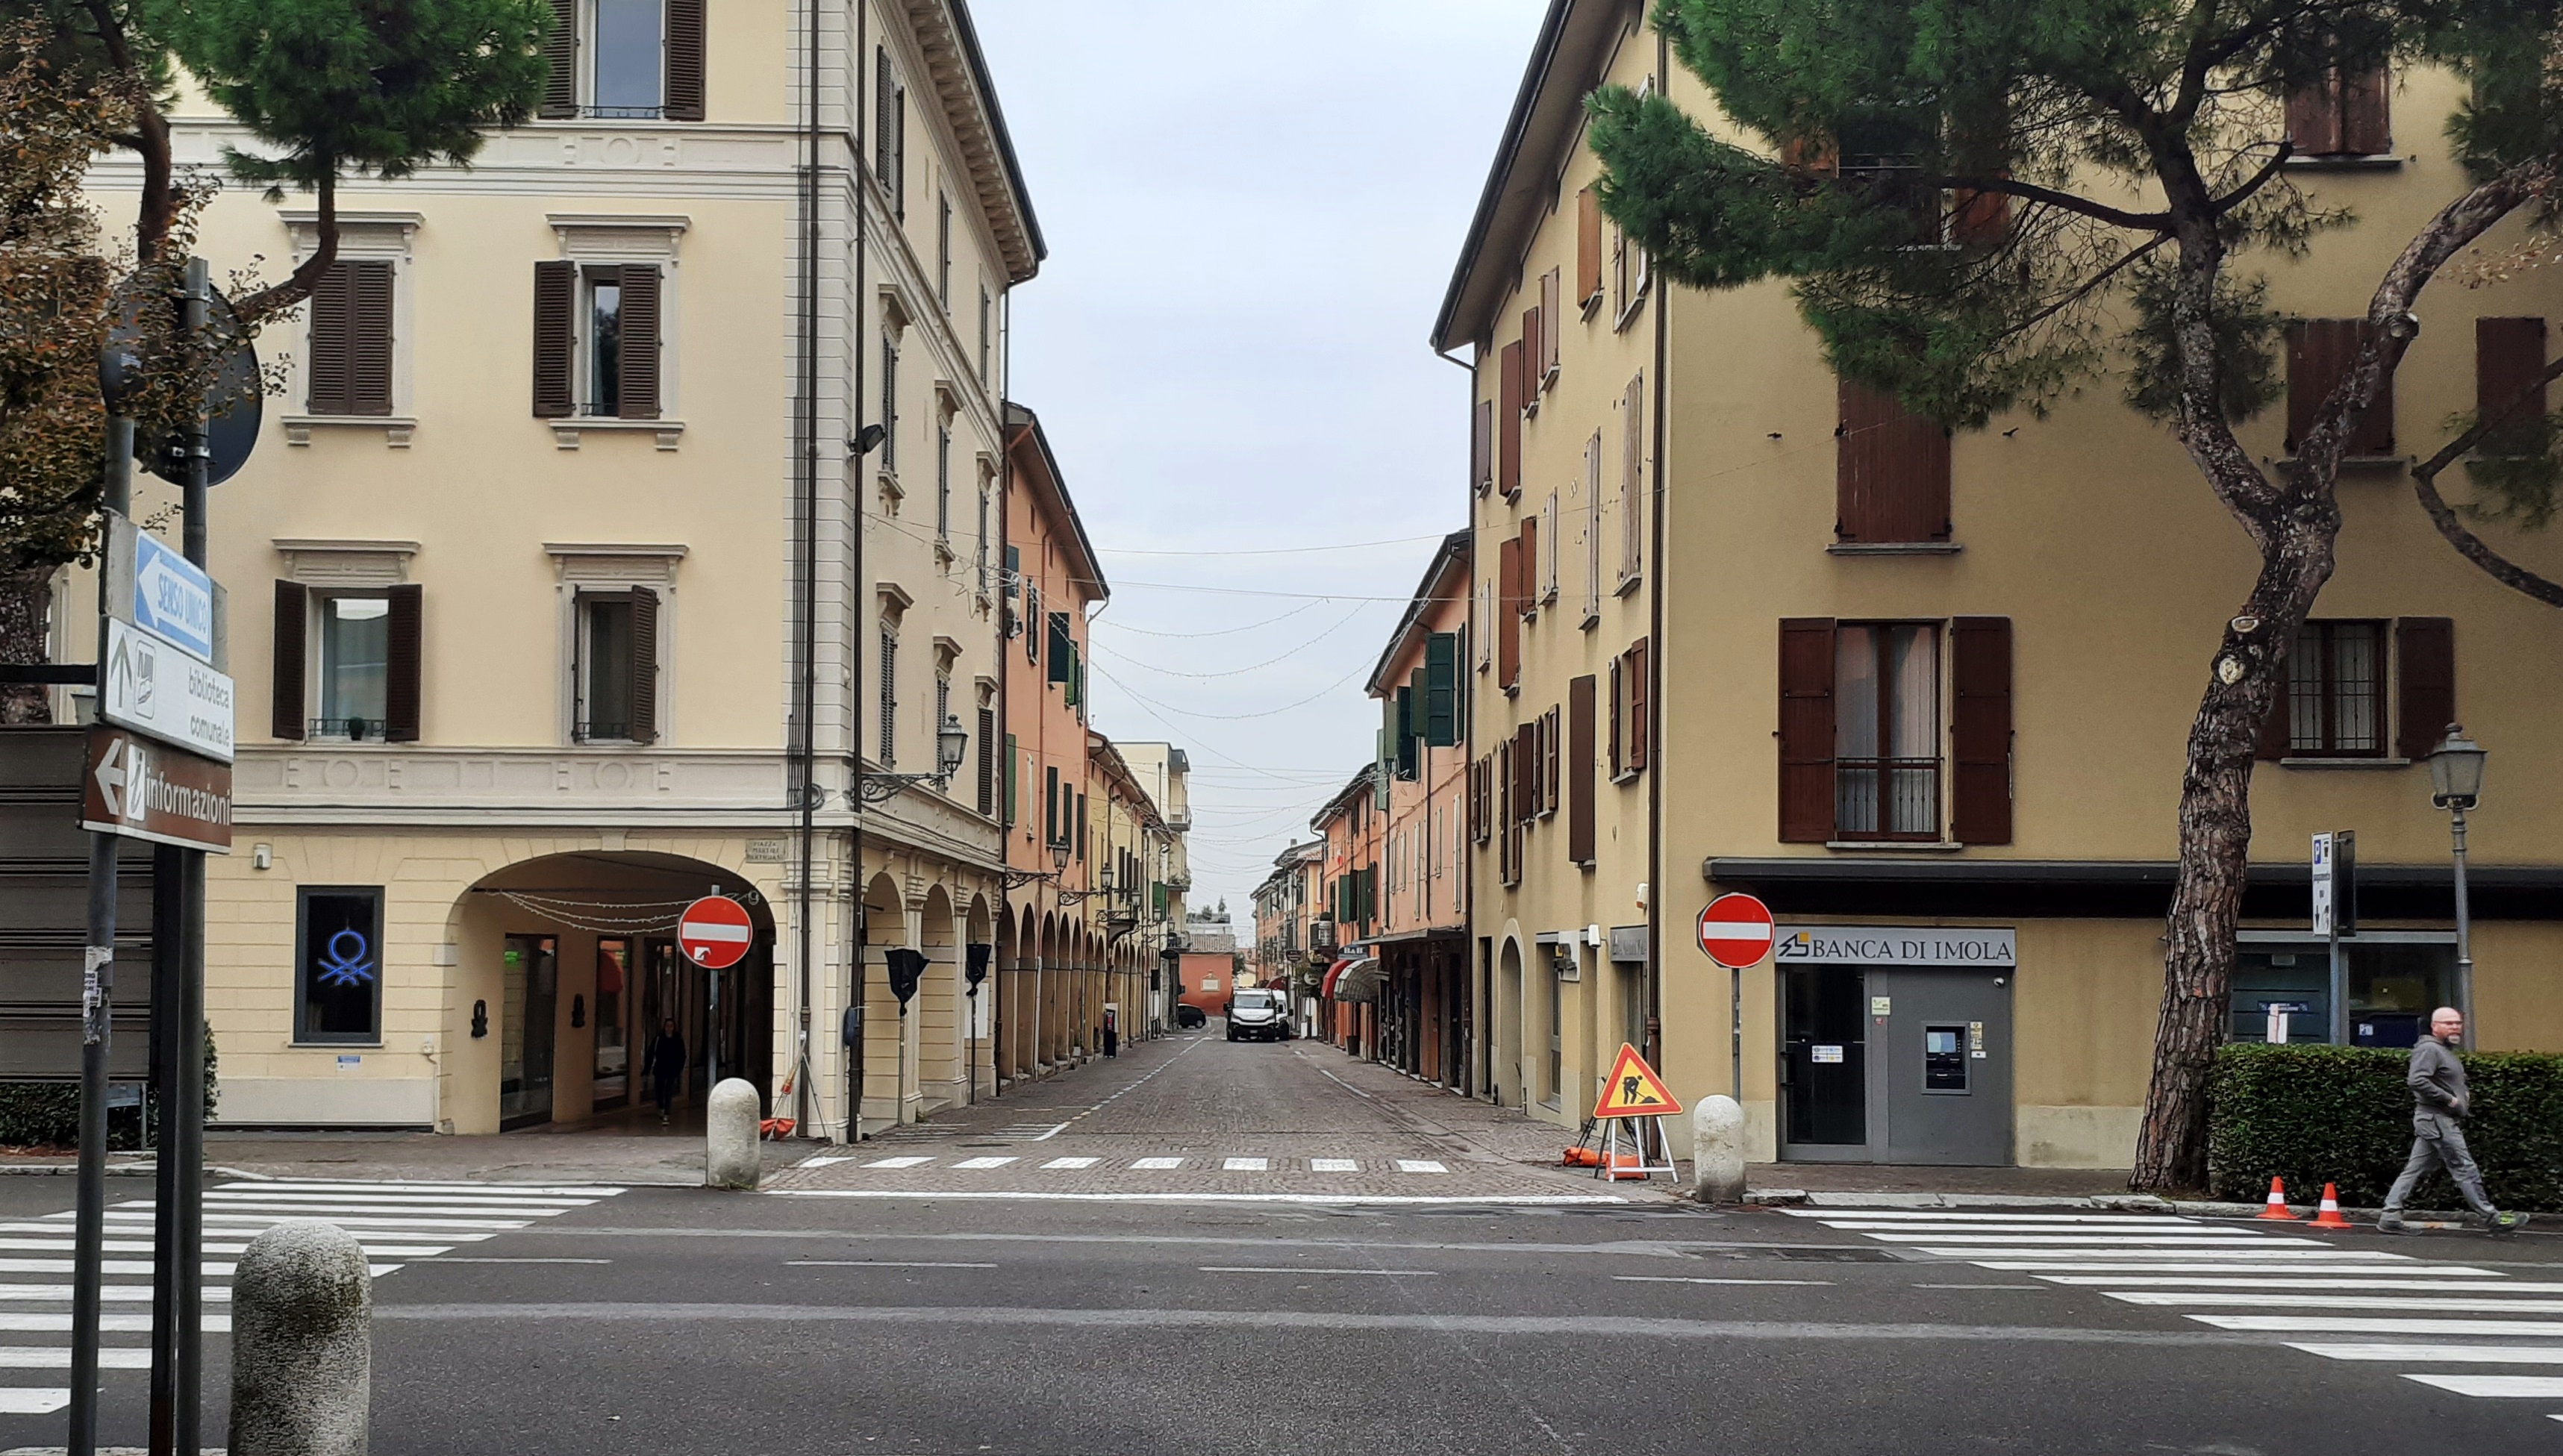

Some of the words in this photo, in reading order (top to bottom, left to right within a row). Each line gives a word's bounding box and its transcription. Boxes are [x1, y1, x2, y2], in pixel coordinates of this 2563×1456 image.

[157, 572, 184, 620] SENSO
[184, 588, 207, 634] UNICO
[189, 666, 229, 709] biblioteca
[190, 715, 230, 748] comunale
[146, 766, 231, 826] informazioni
[1811, 939, 1894, 959] BANCA
[1901, 940, 1926, 960] DI
[1934, 941, 2013, 960] IMOLA
